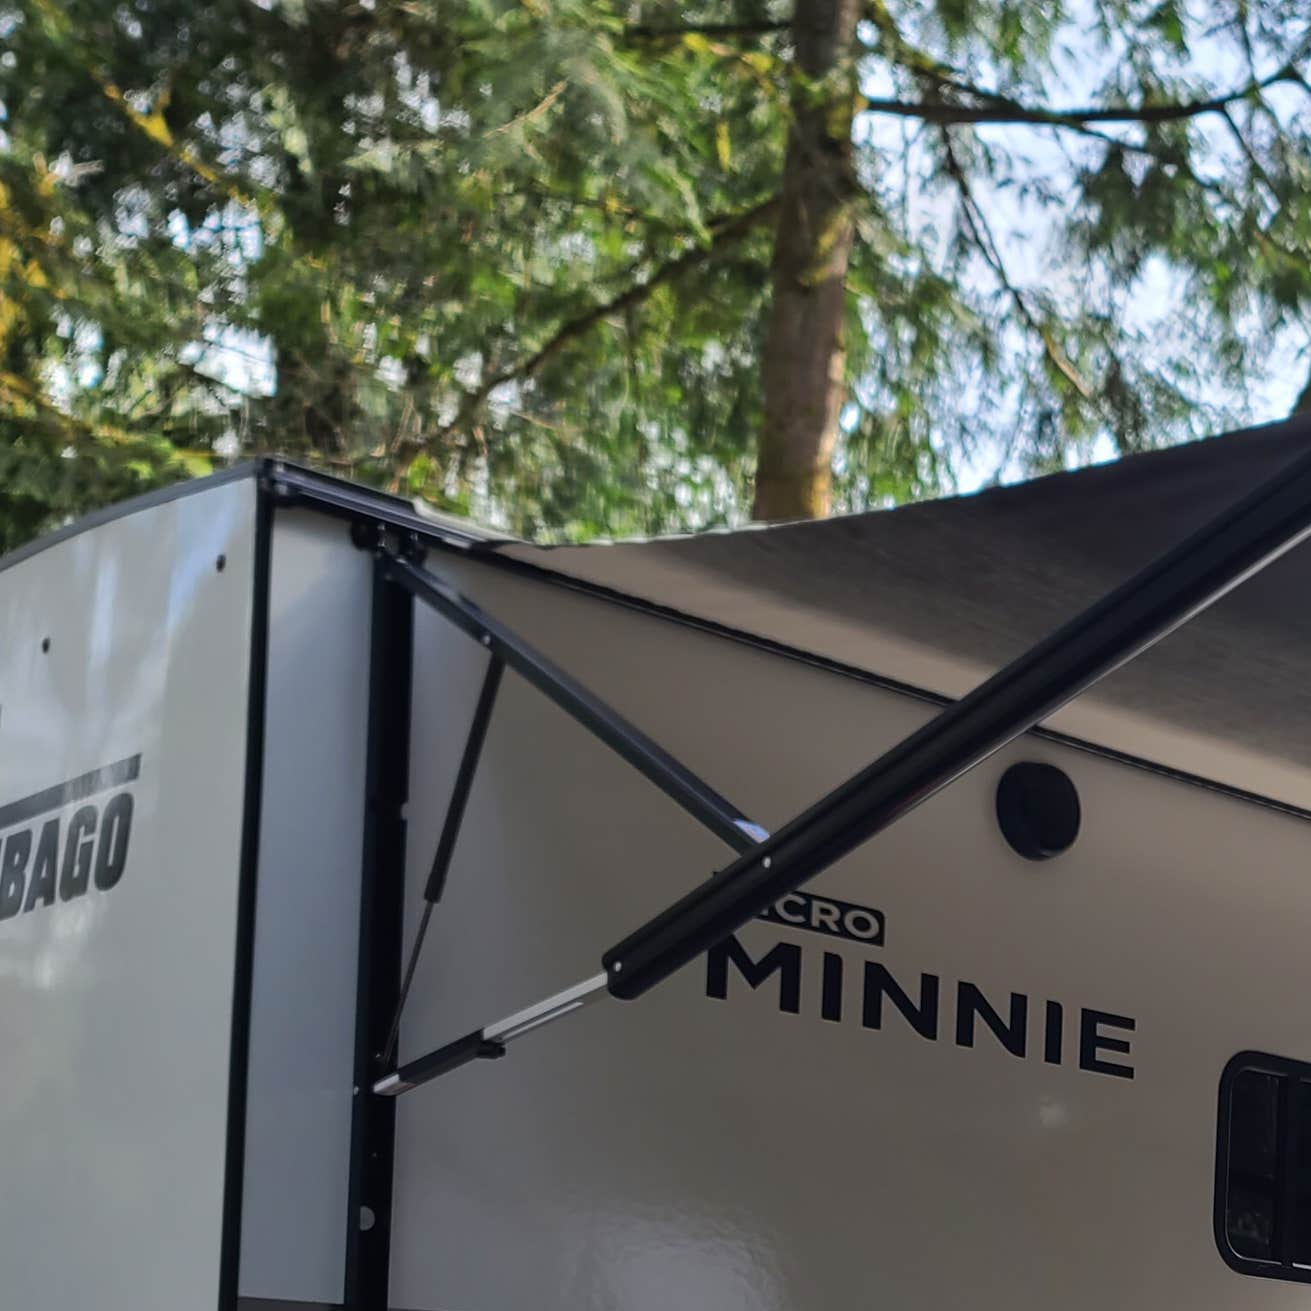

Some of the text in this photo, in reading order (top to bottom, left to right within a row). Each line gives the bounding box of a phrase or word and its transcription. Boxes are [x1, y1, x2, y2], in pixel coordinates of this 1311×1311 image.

[0, 793, 134, 921] BAGO
[764, 896, 880, 940] CRO
[706, 934, 1137, 1080] MINNIE
